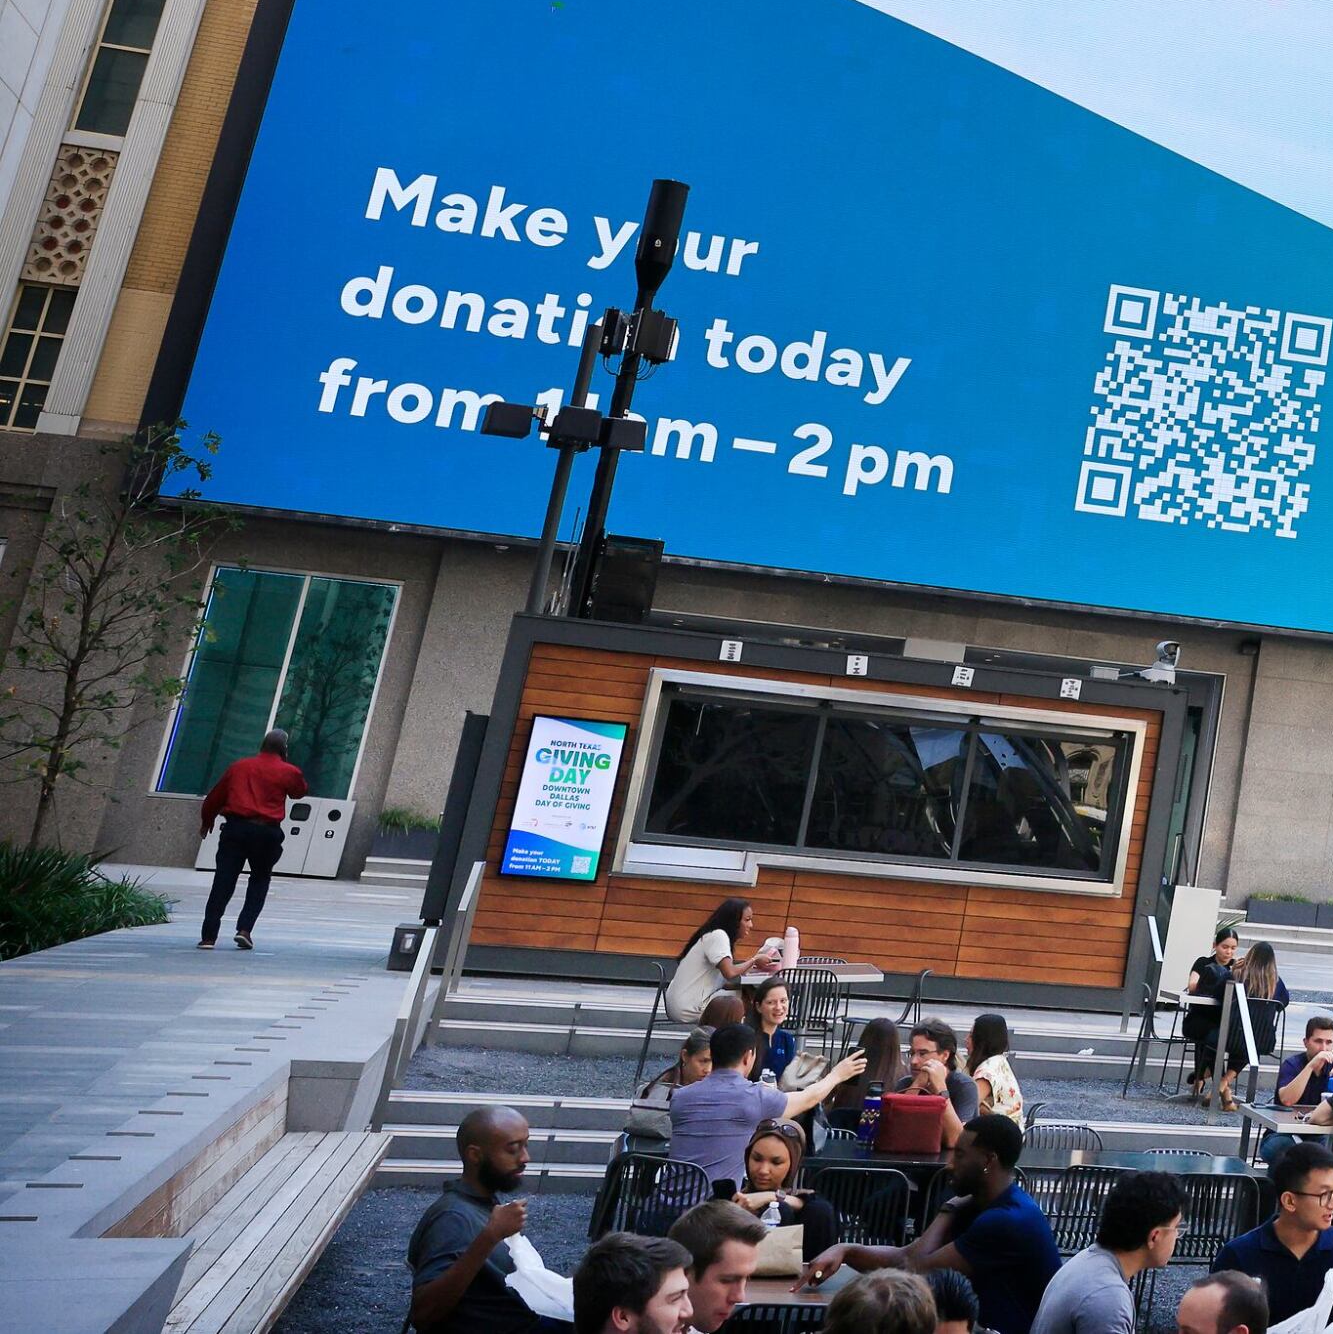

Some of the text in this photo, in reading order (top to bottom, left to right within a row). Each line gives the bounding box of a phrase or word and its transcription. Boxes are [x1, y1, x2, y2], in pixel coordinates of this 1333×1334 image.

[364, 167, 759, 276] Make yur
[340, 265, 913, 405] donati today
[550, 740, 577, 749] NORTH
[536, 748, 611, 769] GIVING
[549, 767, 591, 784] DAY
[542, 784, 591, 795] DOWNTOWN
[549, 793, 580, 802] DALLAS
[535, 799, 551, 807] DAY
[564, 802, 591, 811] GIVING
[538, 857, 561, 865] TODAY
